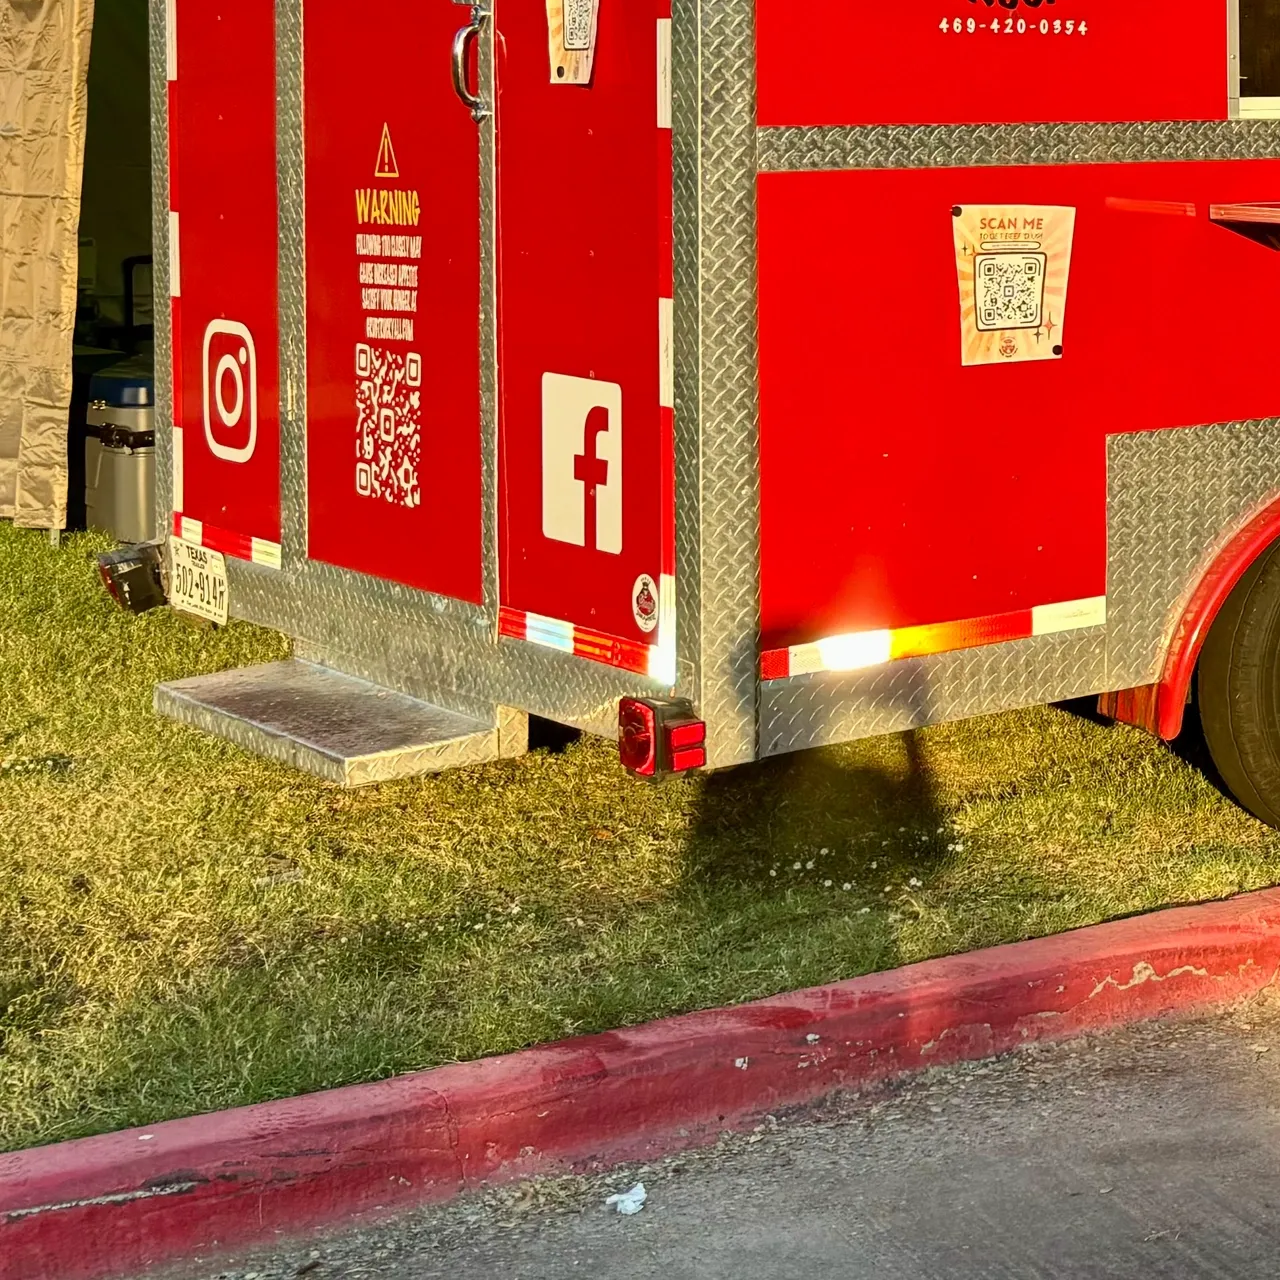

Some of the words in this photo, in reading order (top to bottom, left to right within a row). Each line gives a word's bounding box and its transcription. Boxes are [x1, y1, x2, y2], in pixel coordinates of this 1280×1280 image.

[939, 17, 1088, 35] 469-420-0354
[355, 188, 420, 226] WARNING
[980, 218, 1017, 230] SCAN
[1023, 218, 1043, 230] ME
[186, 545, 207, 564] TEXAS
